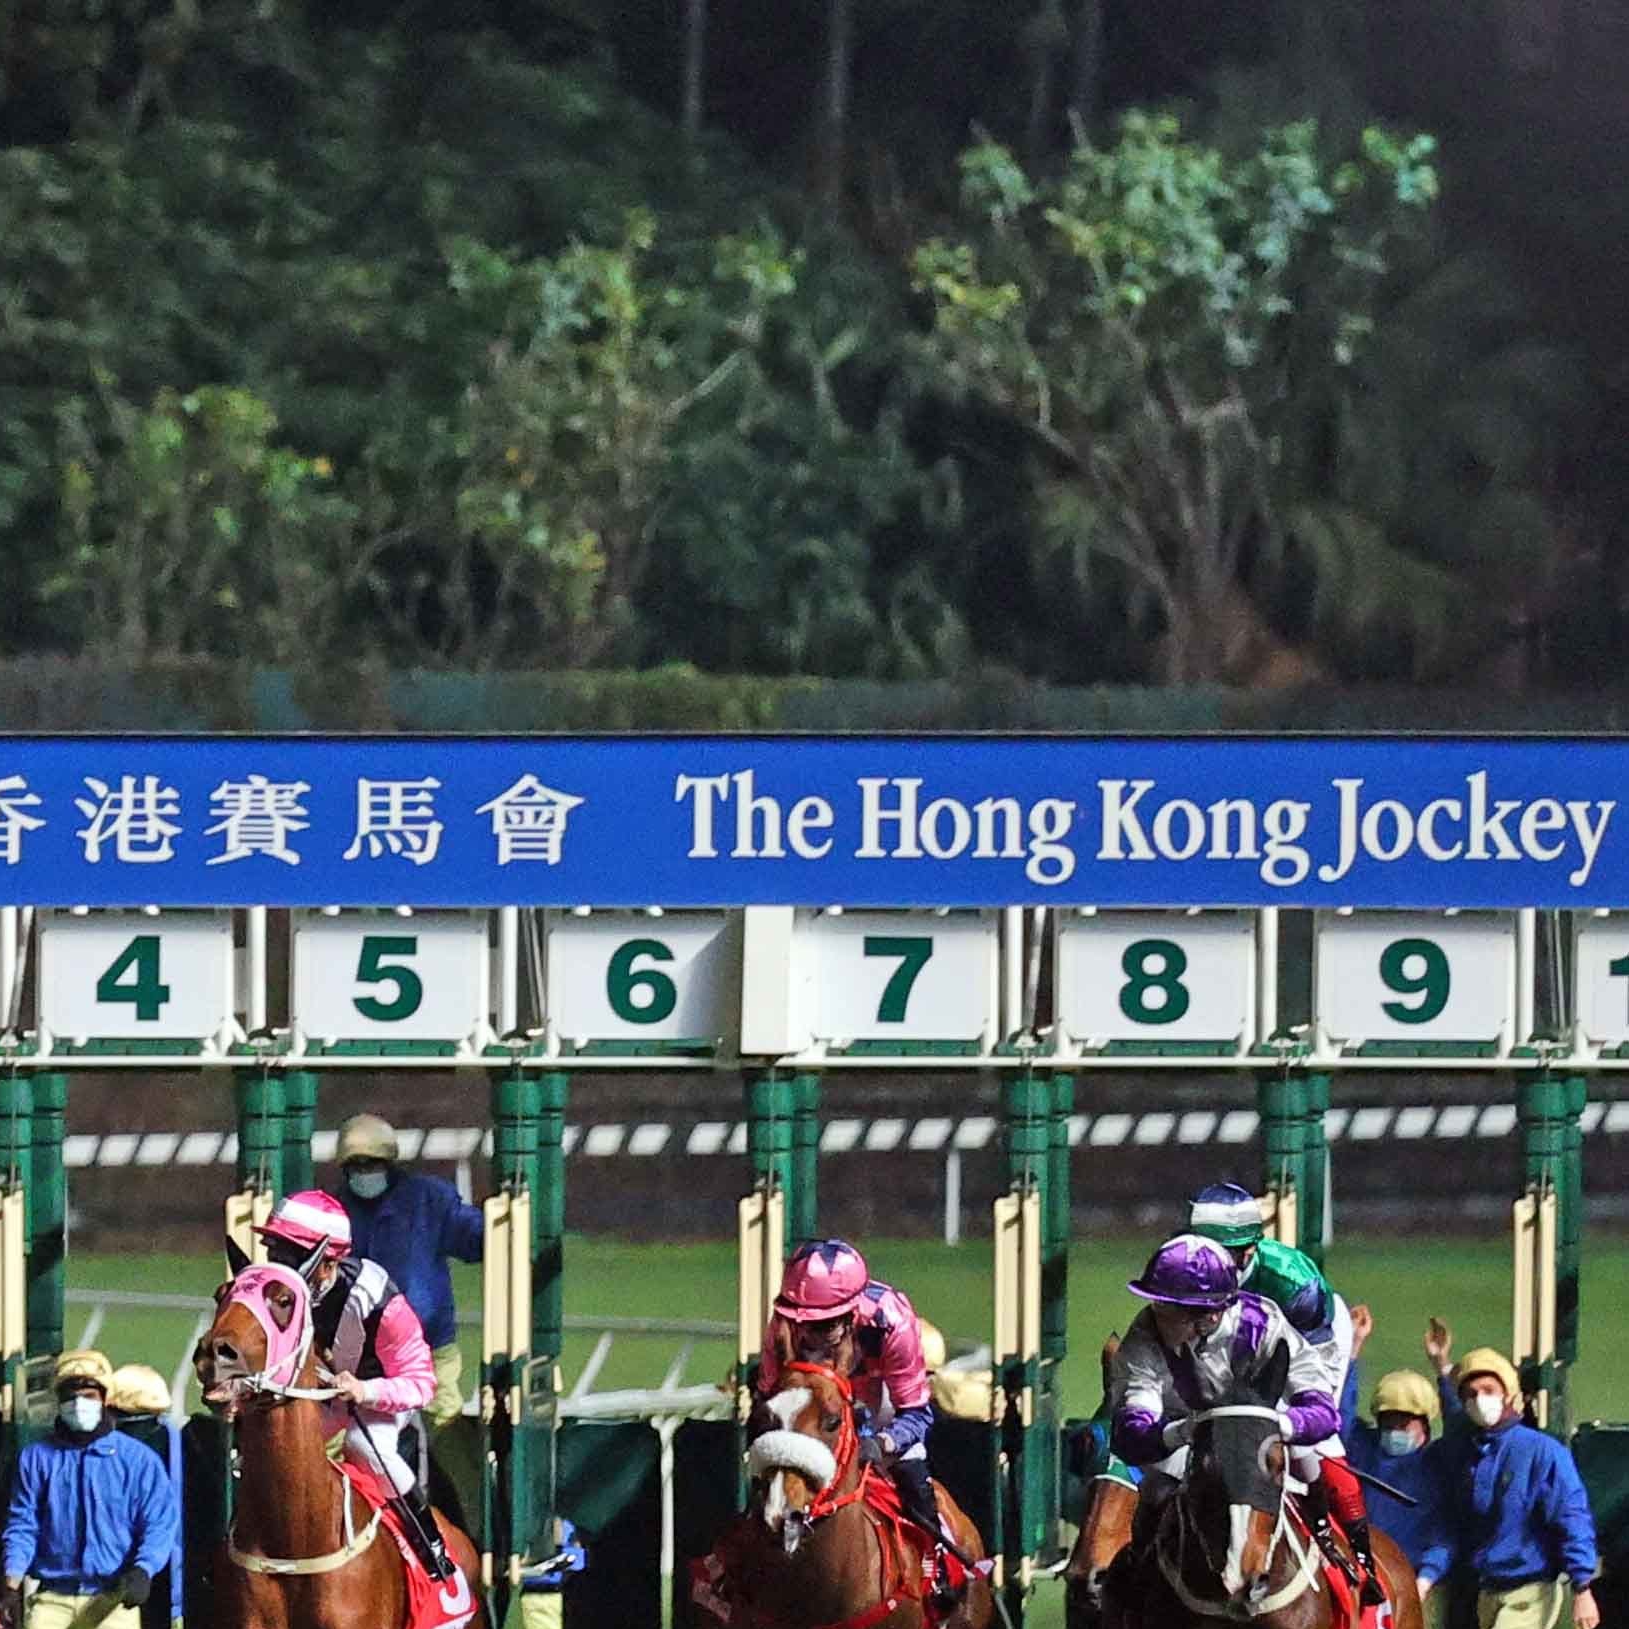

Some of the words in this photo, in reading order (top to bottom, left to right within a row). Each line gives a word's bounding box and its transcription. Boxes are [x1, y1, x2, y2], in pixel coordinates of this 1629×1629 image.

[675, 769, 834, 859] The
[854, 778, 1076, 885] Hong
[1096, 779, 1311, 886] Kong
[1318, 770, 1616, 887] Jockey
[96, 935, 170, 1021] 4
[353, 935, 423, 1022] 5
[606, 938, 677, 1025] 6
[863, 935, 934, 1023] 7
[1119, 938, 1190, 1025] 8
[1379, 938, 1451, 1025] 9
